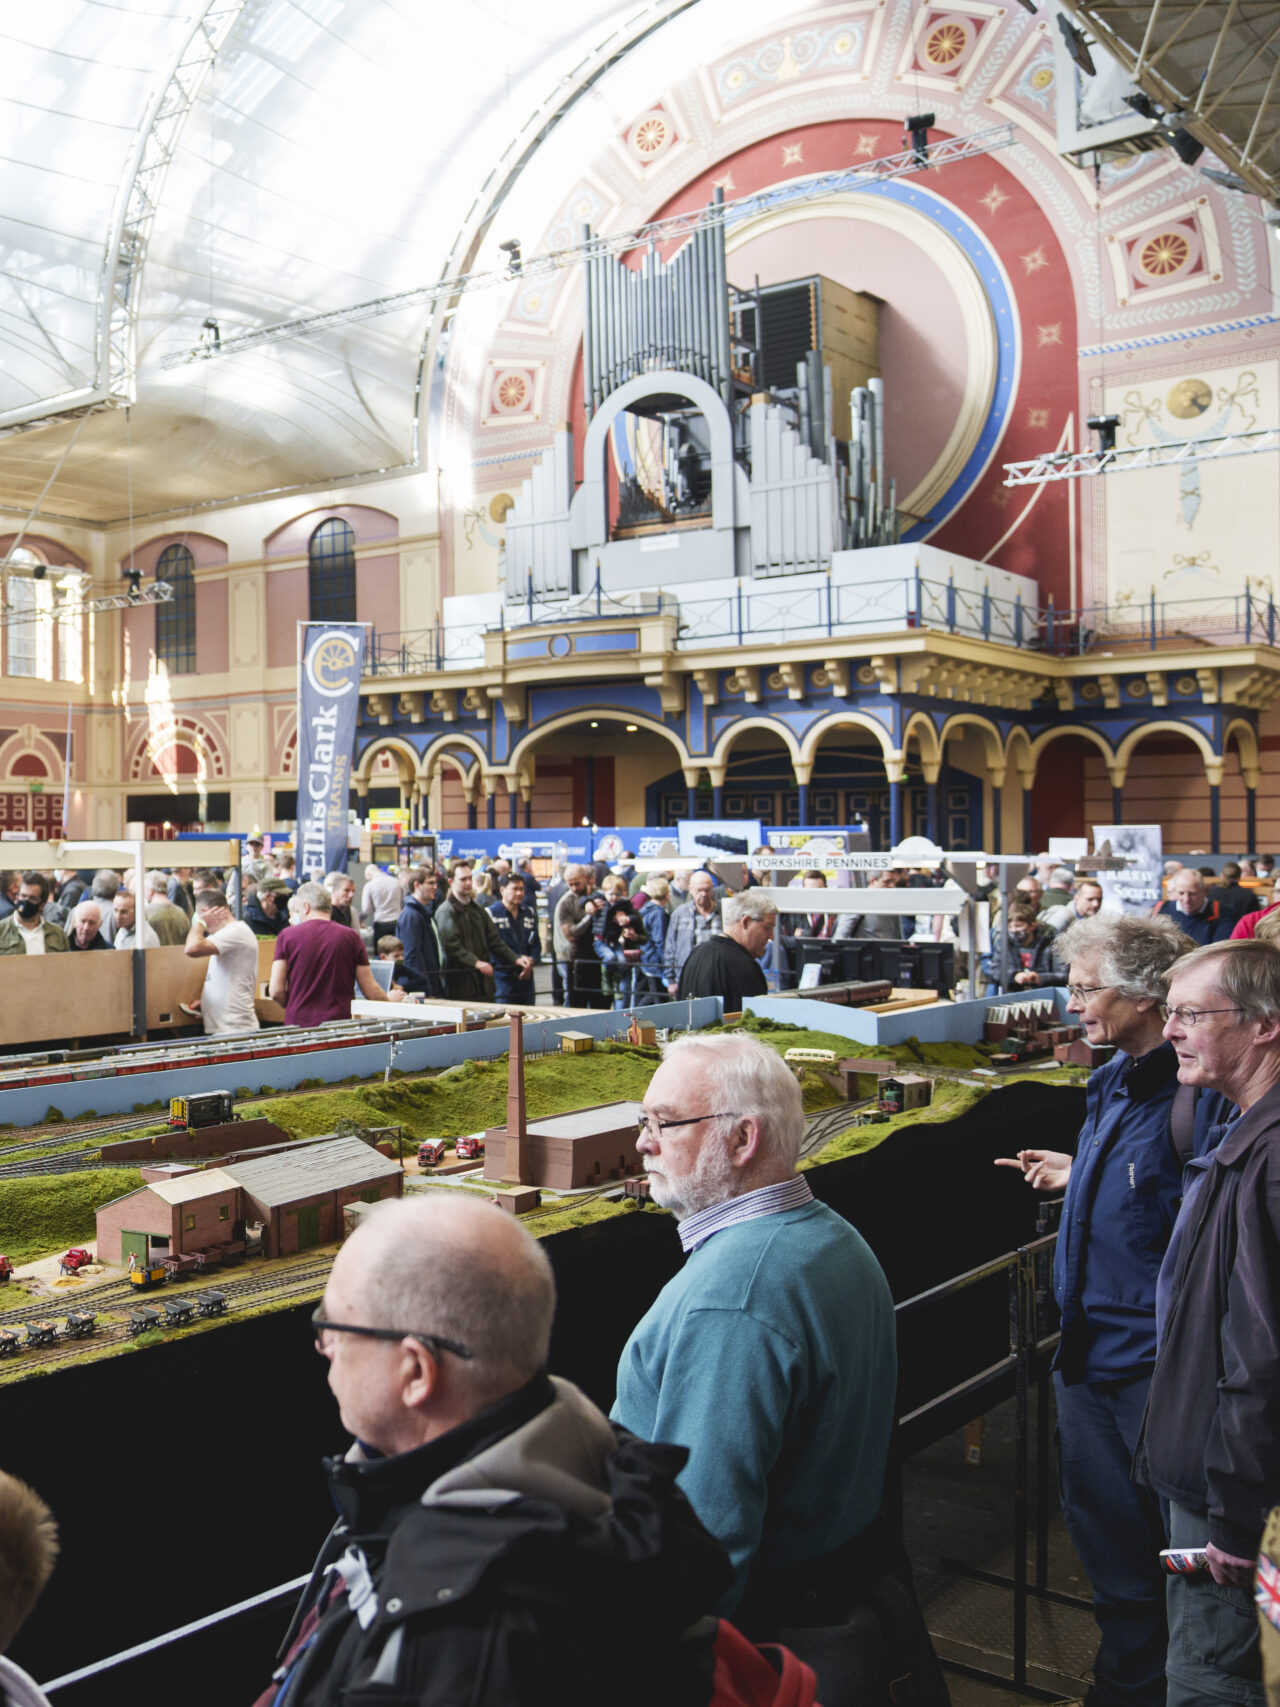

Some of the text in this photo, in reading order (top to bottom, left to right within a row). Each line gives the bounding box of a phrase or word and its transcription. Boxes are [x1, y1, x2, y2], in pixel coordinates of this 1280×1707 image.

[327, 754, 348, 831] TRAINS
[756, 858, 889, 868] YORKSHIRE PENNINES
[1128, 1163, 1136, 1188] Rohan
